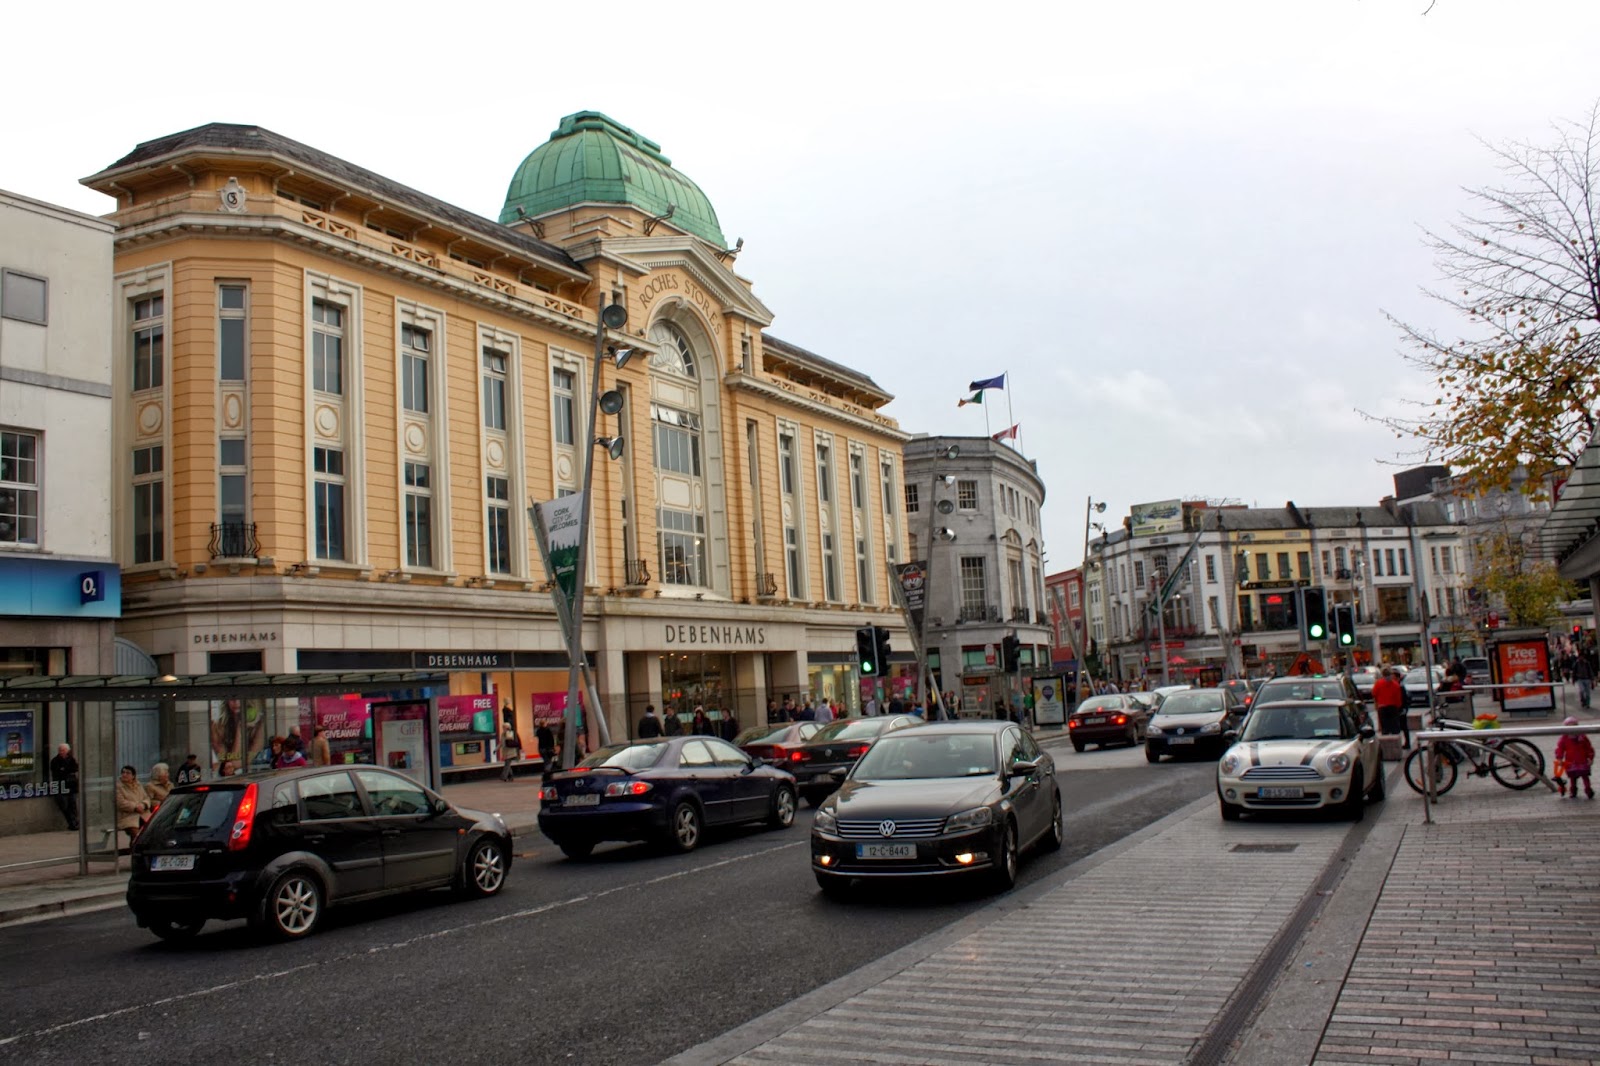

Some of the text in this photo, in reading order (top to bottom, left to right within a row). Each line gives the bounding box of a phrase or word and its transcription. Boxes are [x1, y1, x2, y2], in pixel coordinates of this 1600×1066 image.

[639, 273, 722, 335] ROCHES STORES
[553, 506, 570, 517] CORK
[549, 518, 578, 533] WELCOMES
[194, 632, 278, 644] DEBENHAMS
[665, 624, 766, 645] DEBENHAMS
[1507, 646, 1537, 659] Free
[428, 655, 498, 667] DEBENHAMS
[473, 698, 492, 709] FREE
[439, 706, 458, 719] great
[323, 711, 348, 727] great
[439, 722, 470, 732] GIVEAWAY
[324, 728, 361, 739] GIVEAWAY
[869, 846, 909, 856] 12-C-8443
